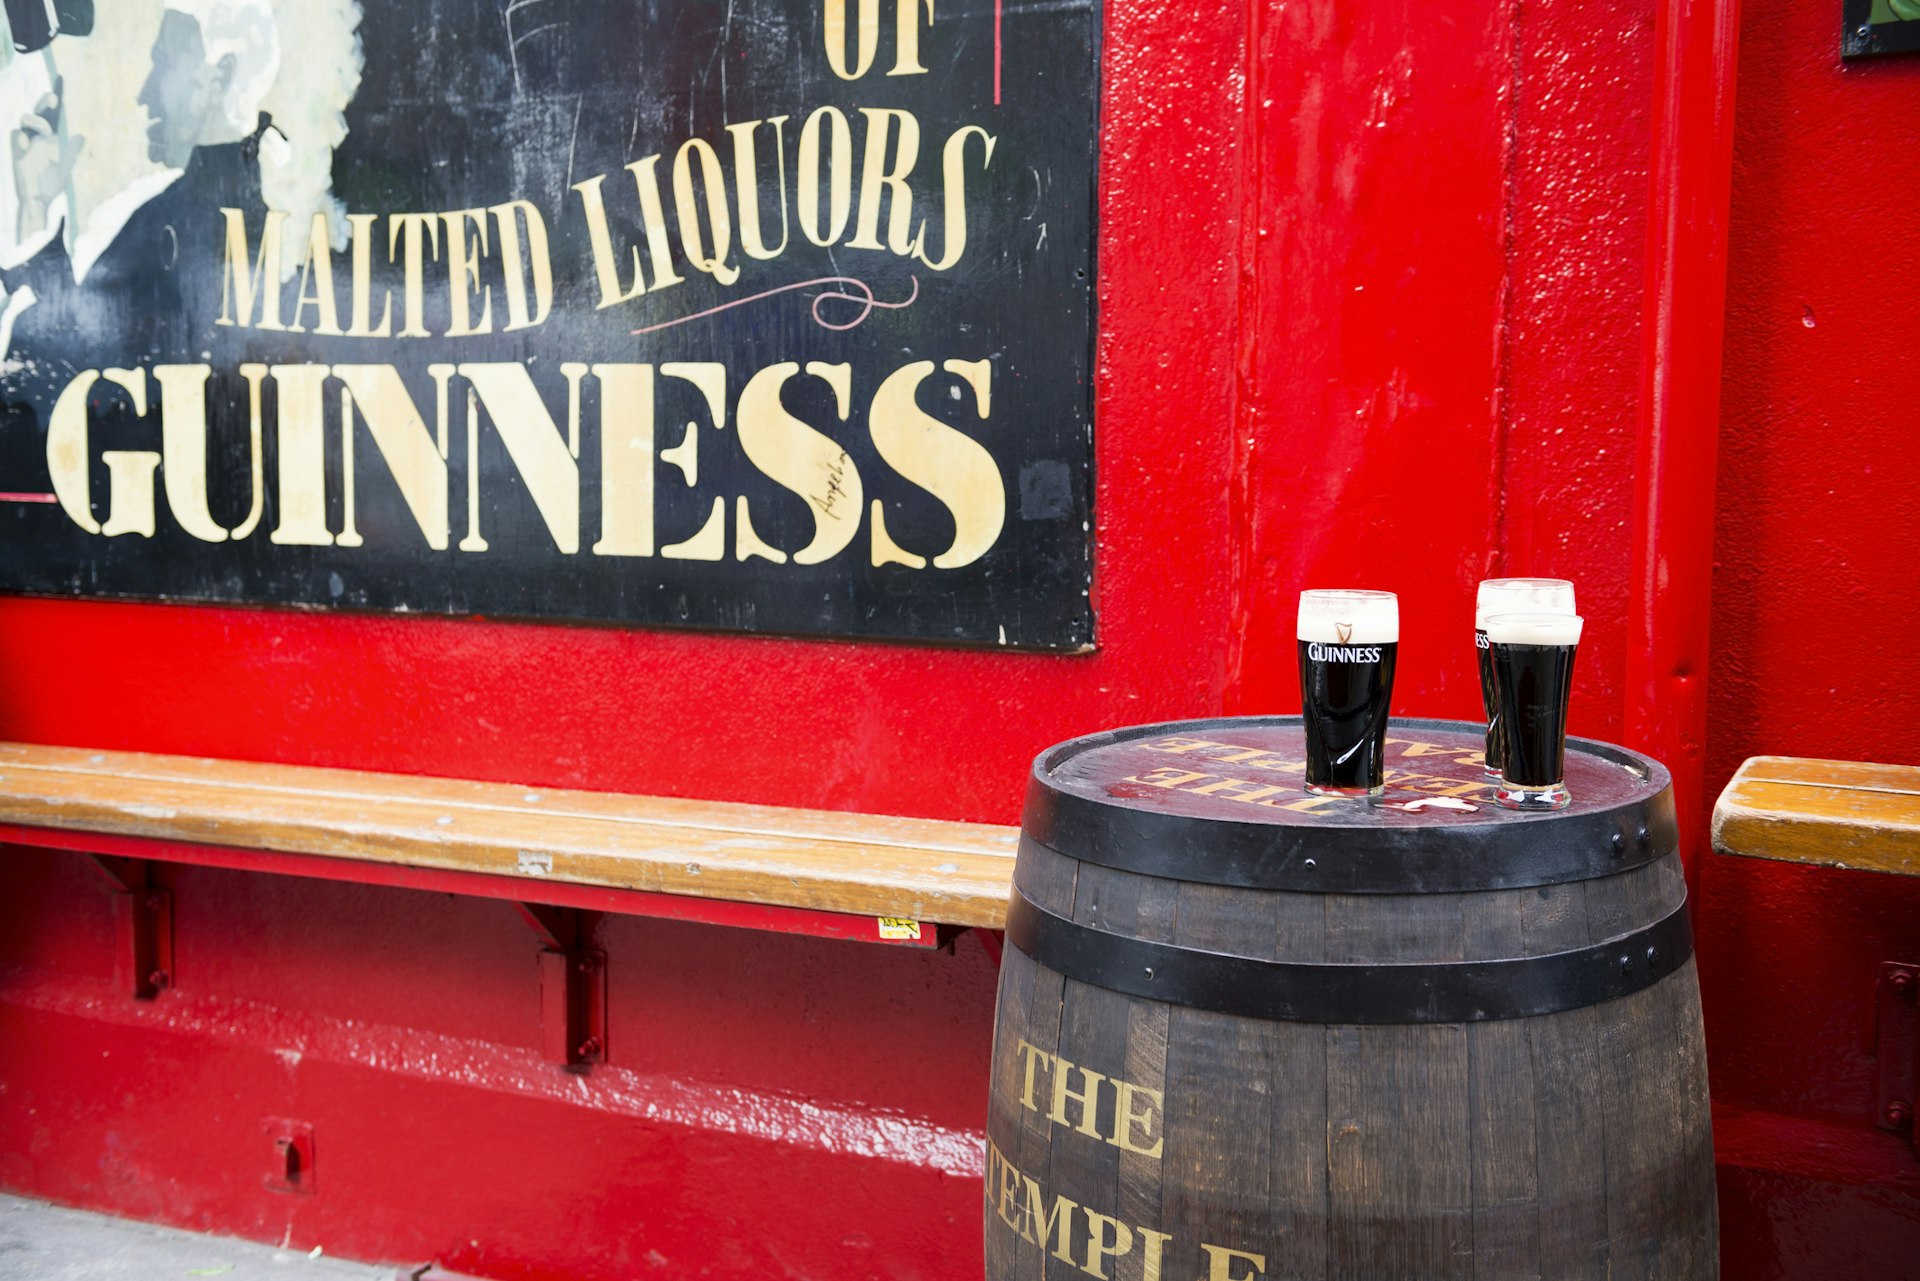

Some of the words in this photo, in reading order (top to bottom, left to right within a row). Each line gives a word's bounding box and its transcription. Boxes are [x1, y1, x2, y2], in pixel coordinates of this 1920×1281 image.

[215, 199, 553, 338] MALTED
[571, 105, 997, 310] LIQUORS
[46, 358, 1006, 569] GUINNESS
[1308, 642, 1380, 663] GUINNESS
[1017, 1038, 1164, 1159] THE
